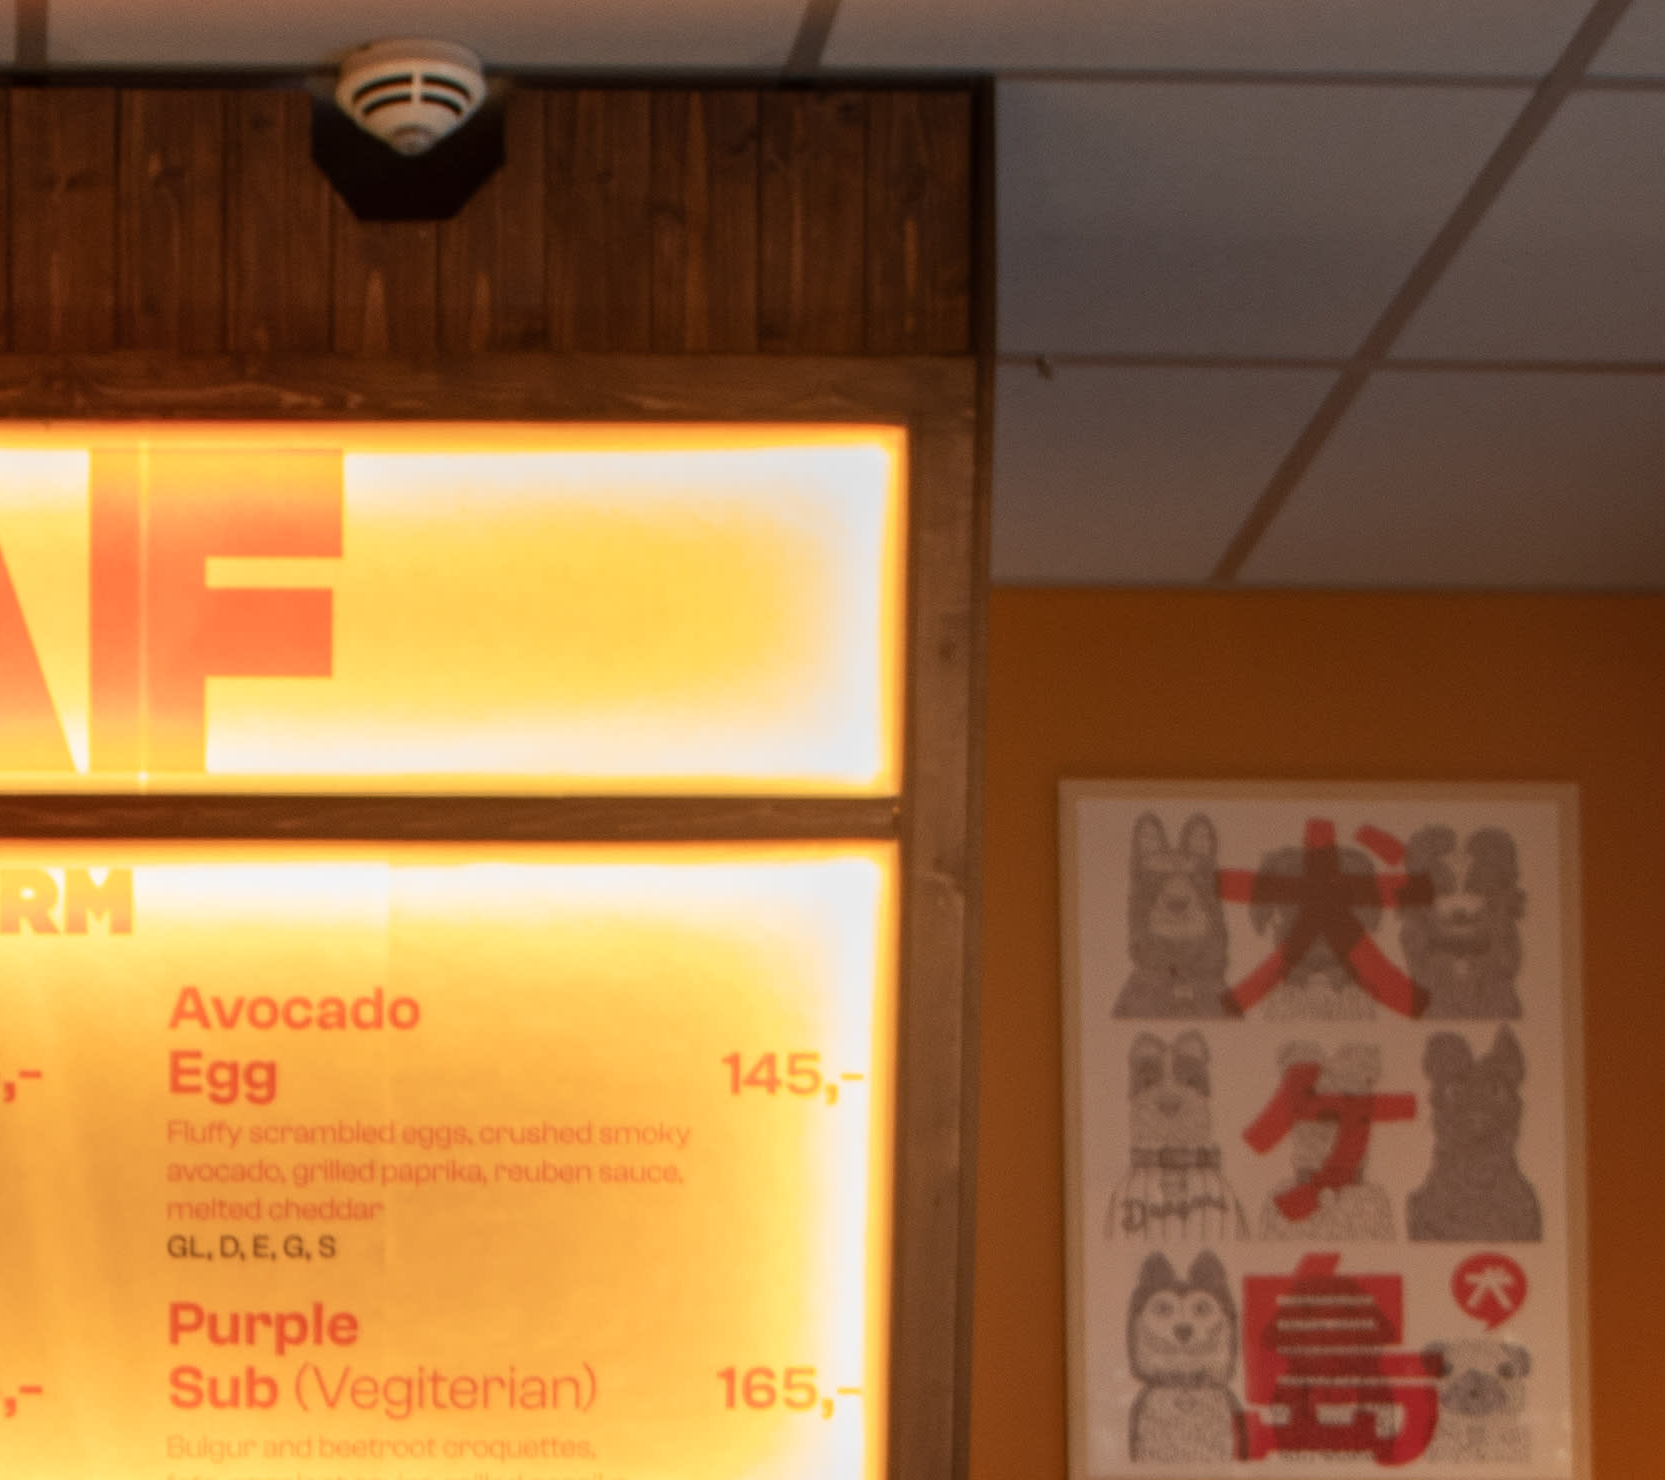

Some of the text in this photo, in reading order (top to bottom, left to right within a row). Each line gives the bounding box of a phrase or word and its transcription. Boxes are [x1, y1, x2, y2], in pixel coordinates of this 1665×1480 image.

[168, 986, 421, 1031] Avocado
[169, 1050, 864, 1106] Egg 145,-
[169, 1301, 359, 1357] Purple
[169, 1361, 861, 1420] Sub (Vegiterian) 165,-
